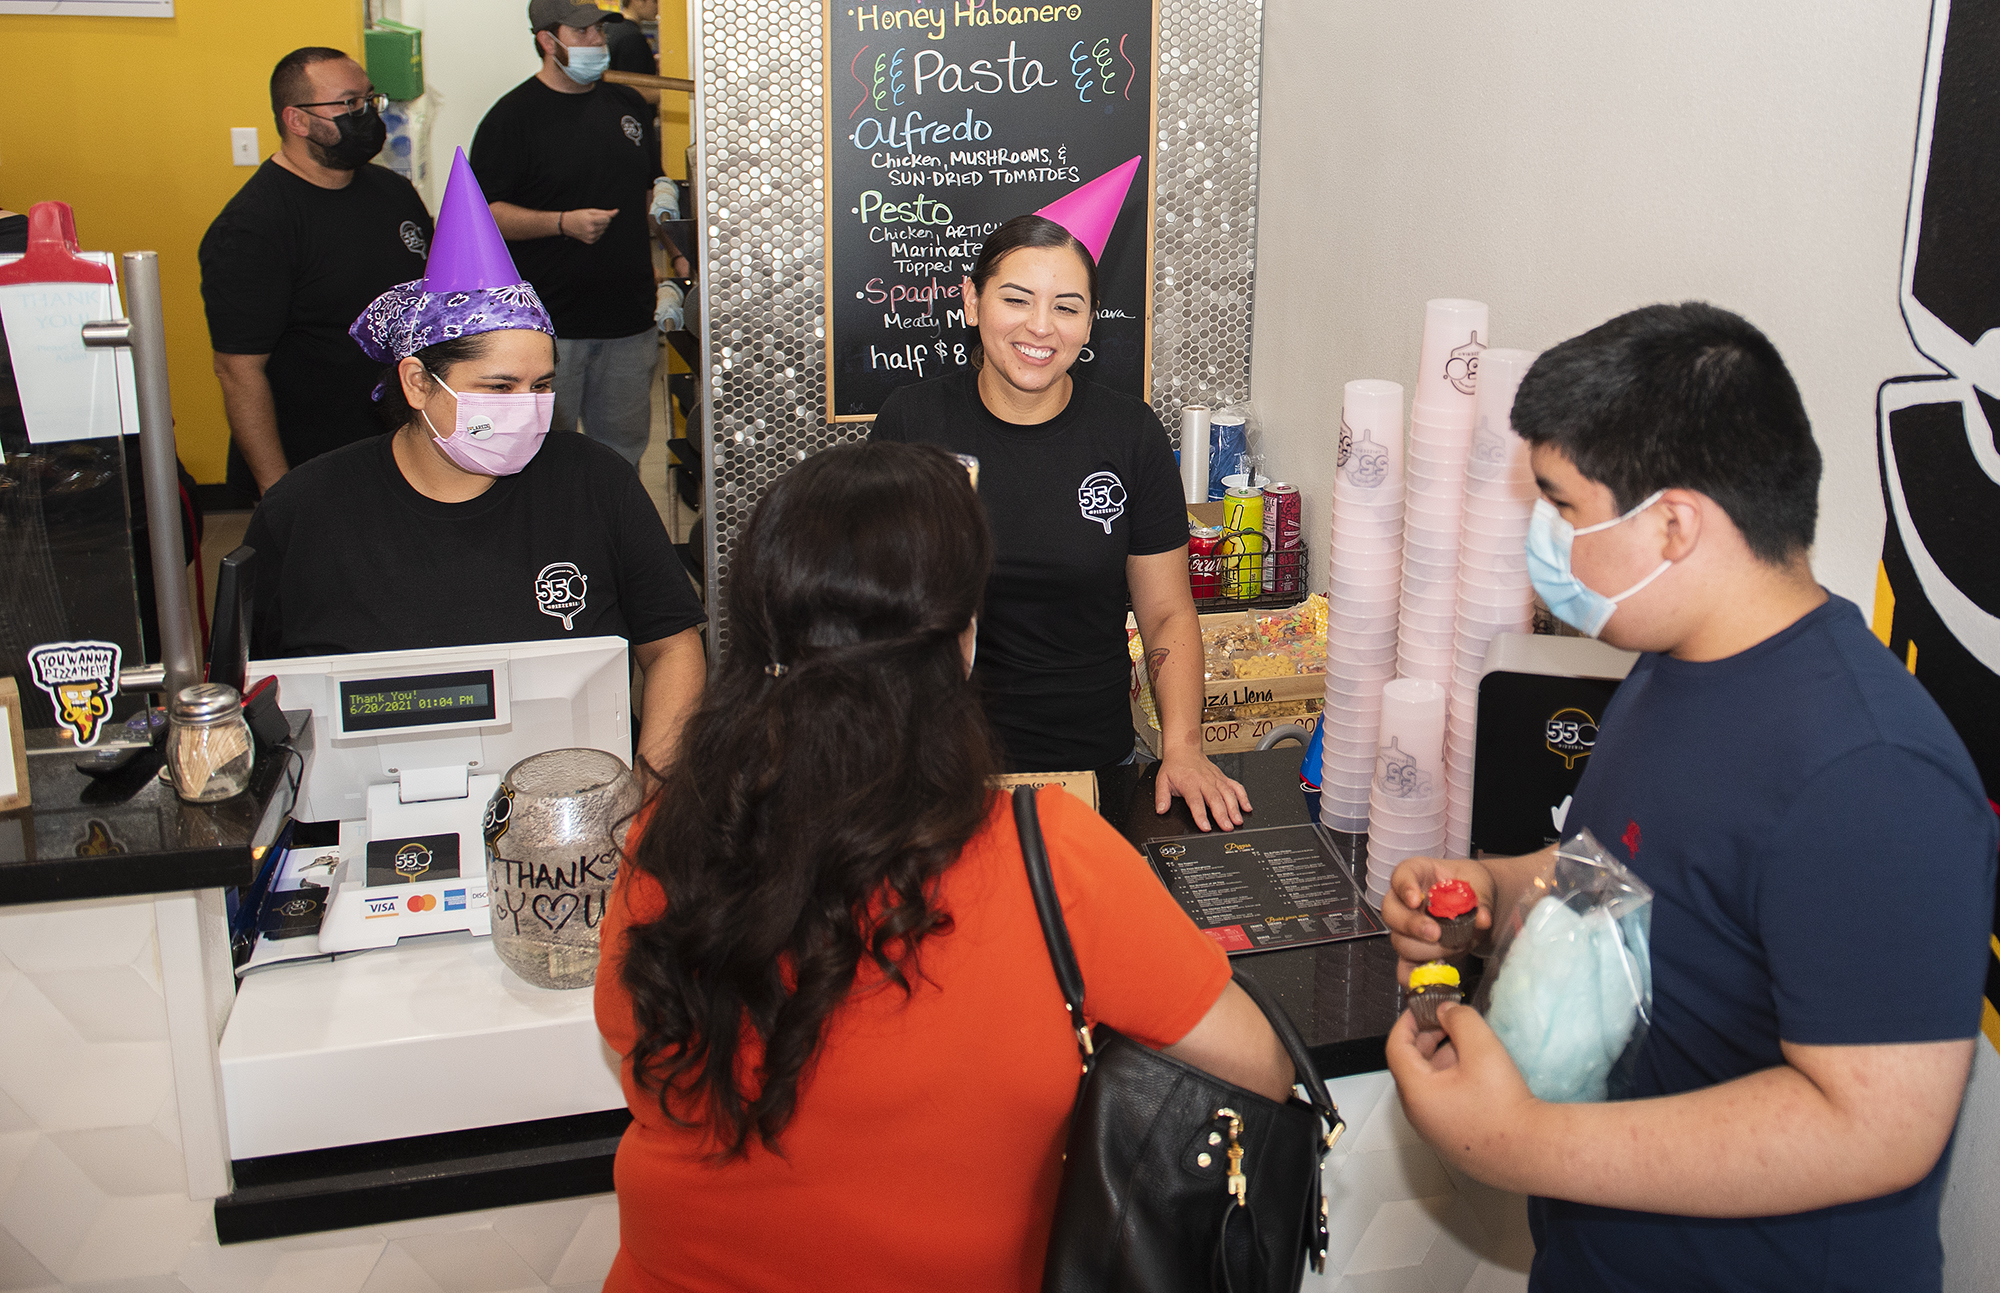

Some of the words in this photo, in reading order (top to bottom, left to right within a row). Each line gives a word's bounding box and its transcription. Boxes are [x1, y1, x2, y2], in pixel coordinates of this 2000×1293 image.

[857, 5, 945, 40] Honey
[954, 0, 1082, 28] Habanero
[914, 40, 1058, 95] Pasta
[871, 152, 948, 171] Chicken,
[950, 148, 1052, 166] MUSHROOMS,
[888, 169, 983, 187] SUN-DRIED
[989, 166, 1081, 187] TOMATOES
[859, 190, 953, 225] Pesto
[869, 225, 941, 246] Chicken,
[893, 259, 952, 277] Topped
[884, 311, 941, 338] Meaty
[870, 343, 928, 377] half
[40, 654, 65, 667] YOU
[67, 652, 109, 666] WANNA
[350, 693, 385, 704] Thank
[391, 690, 417, 701] You!
[350, 701, 412, 714] 6/20/2021
[419, 697, 453, 709] 01:04
[459, 695, 474, 705] PM
[1233, 686, 1273, 704] Llena
[370, 902, 395, 913] VISA
